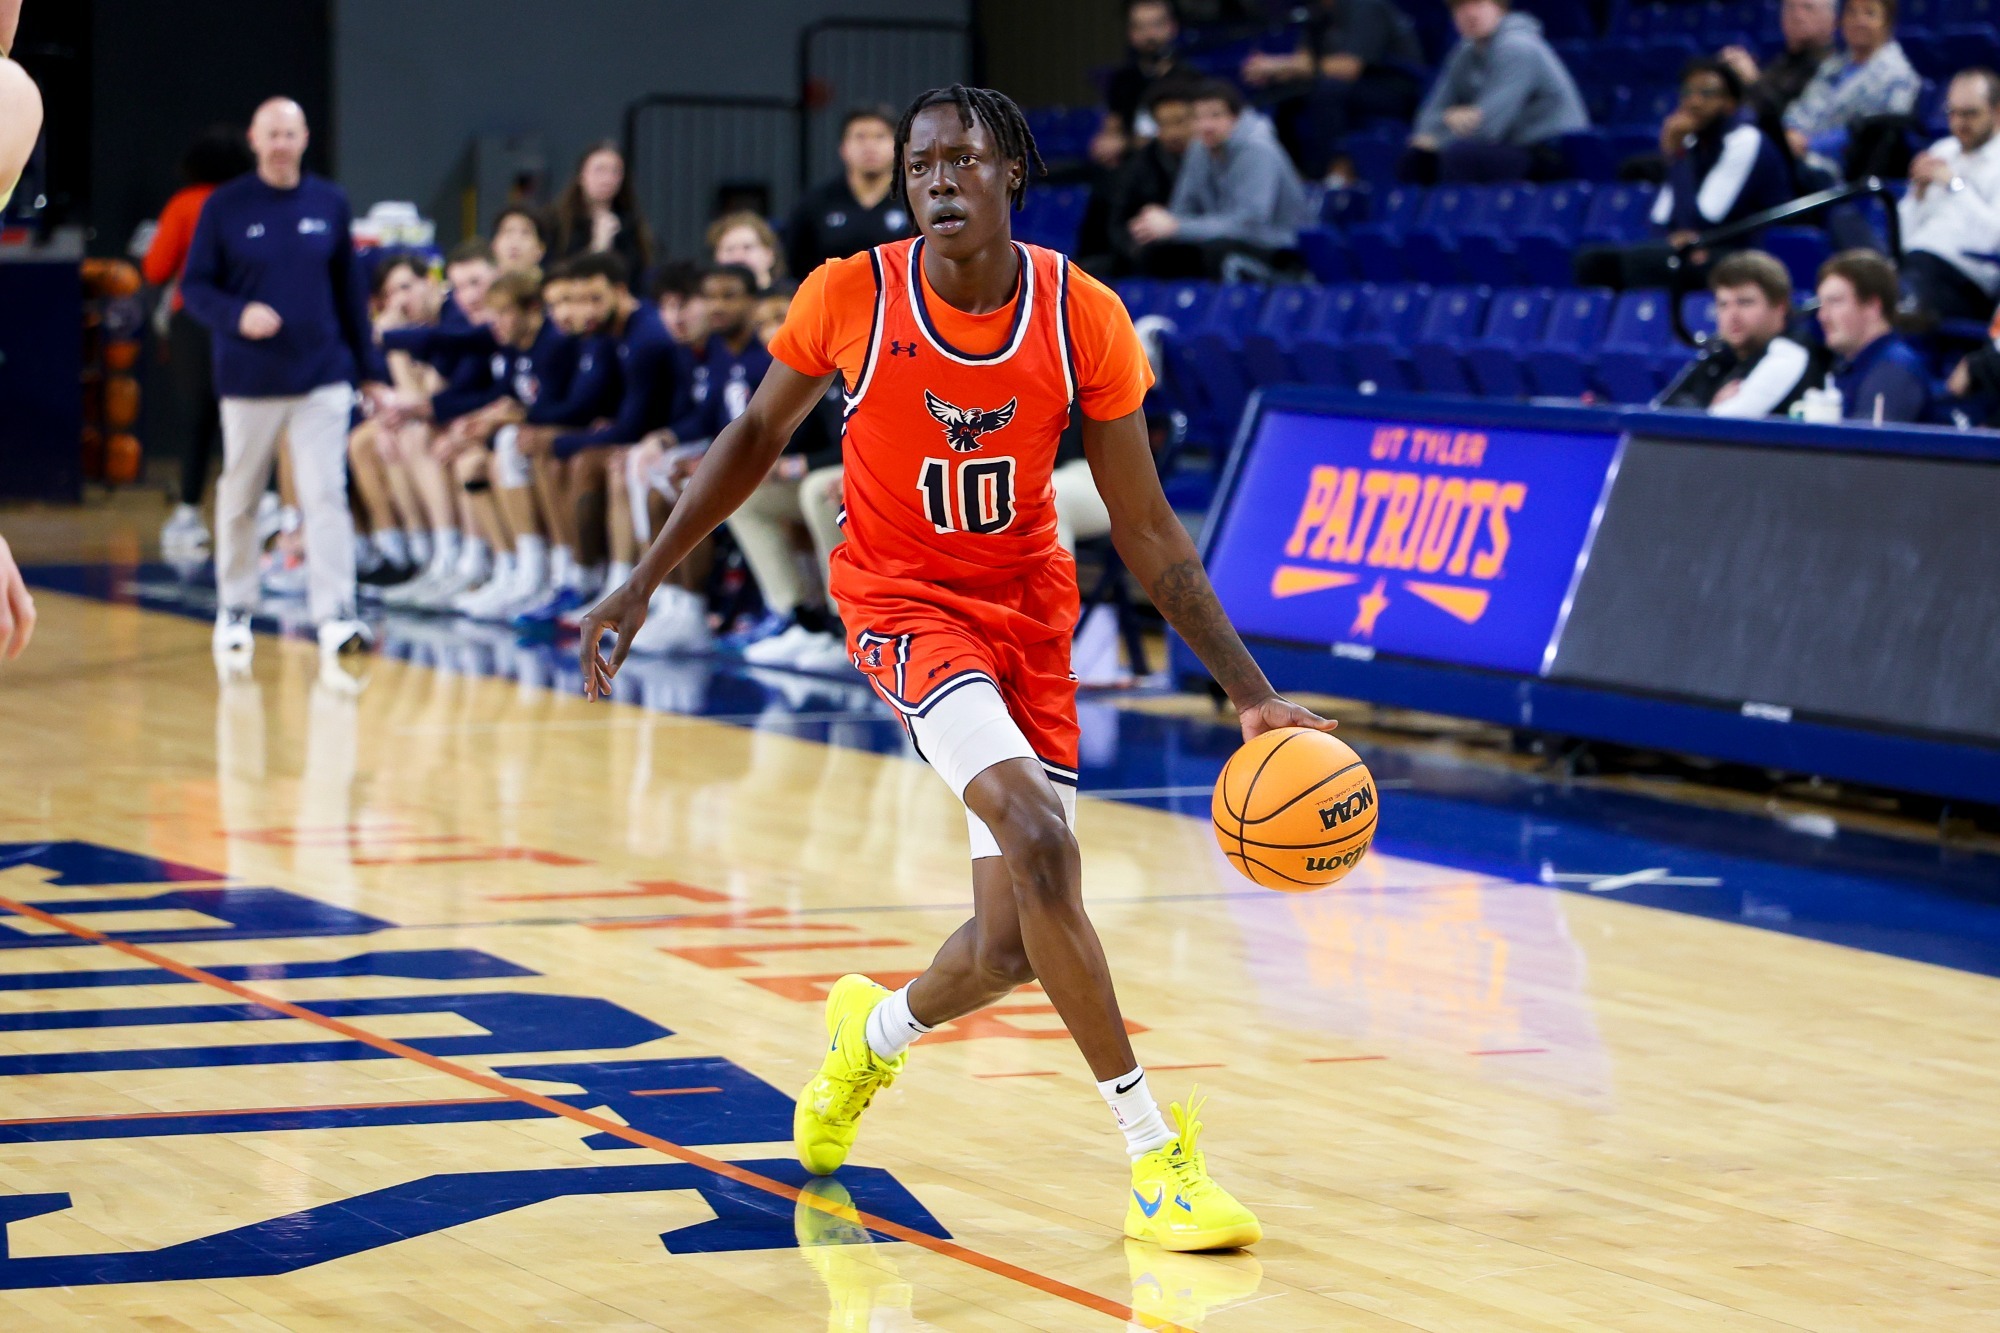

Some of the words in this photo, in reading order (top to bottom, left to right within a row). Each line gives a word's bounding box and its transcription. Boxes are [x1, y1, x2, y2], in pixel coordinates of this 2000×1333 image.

[1371, 427, 1407, 461] UT
[1409, 430, 1488, 467] TYLER
[916, 455, 1016, 534] 10
[1285, 464, 1528, 579] PATRIOTS
[1319, 782, 1373, 829] NCAA
[1306, 840, 1370, 871] lson
